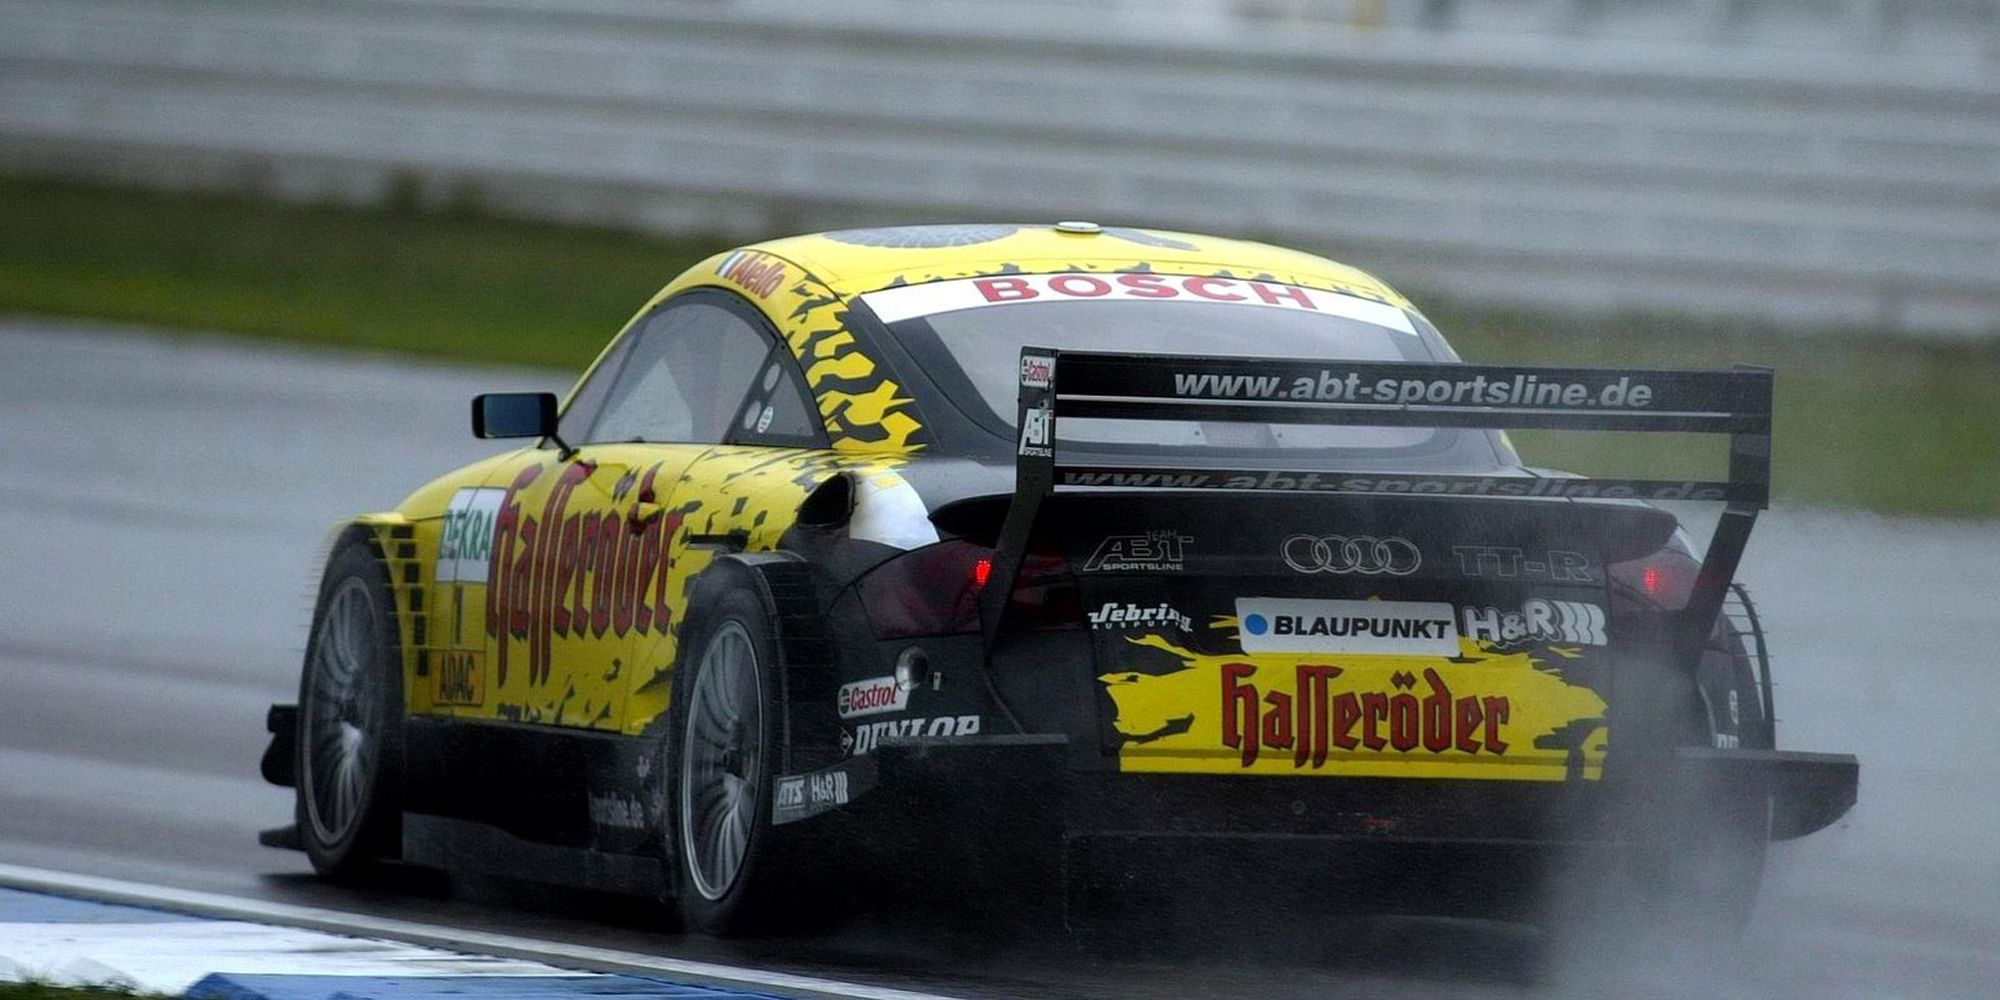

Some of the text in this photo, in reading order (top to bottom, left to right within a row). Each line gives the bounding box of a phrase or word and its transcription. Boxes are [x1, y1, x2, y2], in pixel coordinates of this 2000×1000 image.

[973, 275, 1319, 310] BOSCH
[1174, 369, 1653, 408] www.abt-sportsline.de
[439, 508, 493, 560] DEKRA
[1083, 535, 1194, 571] ABT
[1103, 562, 1184, 571] SPORTSLINE
[1452, 545, 1594, 582] TT-R
[1273, 614, 1451, 639] BLAUPUNKT
[1463, 597, 1560, 642] H&R
[439, 652, 476, 703] ADAC
[850, 684, 897, 711] Castrol
